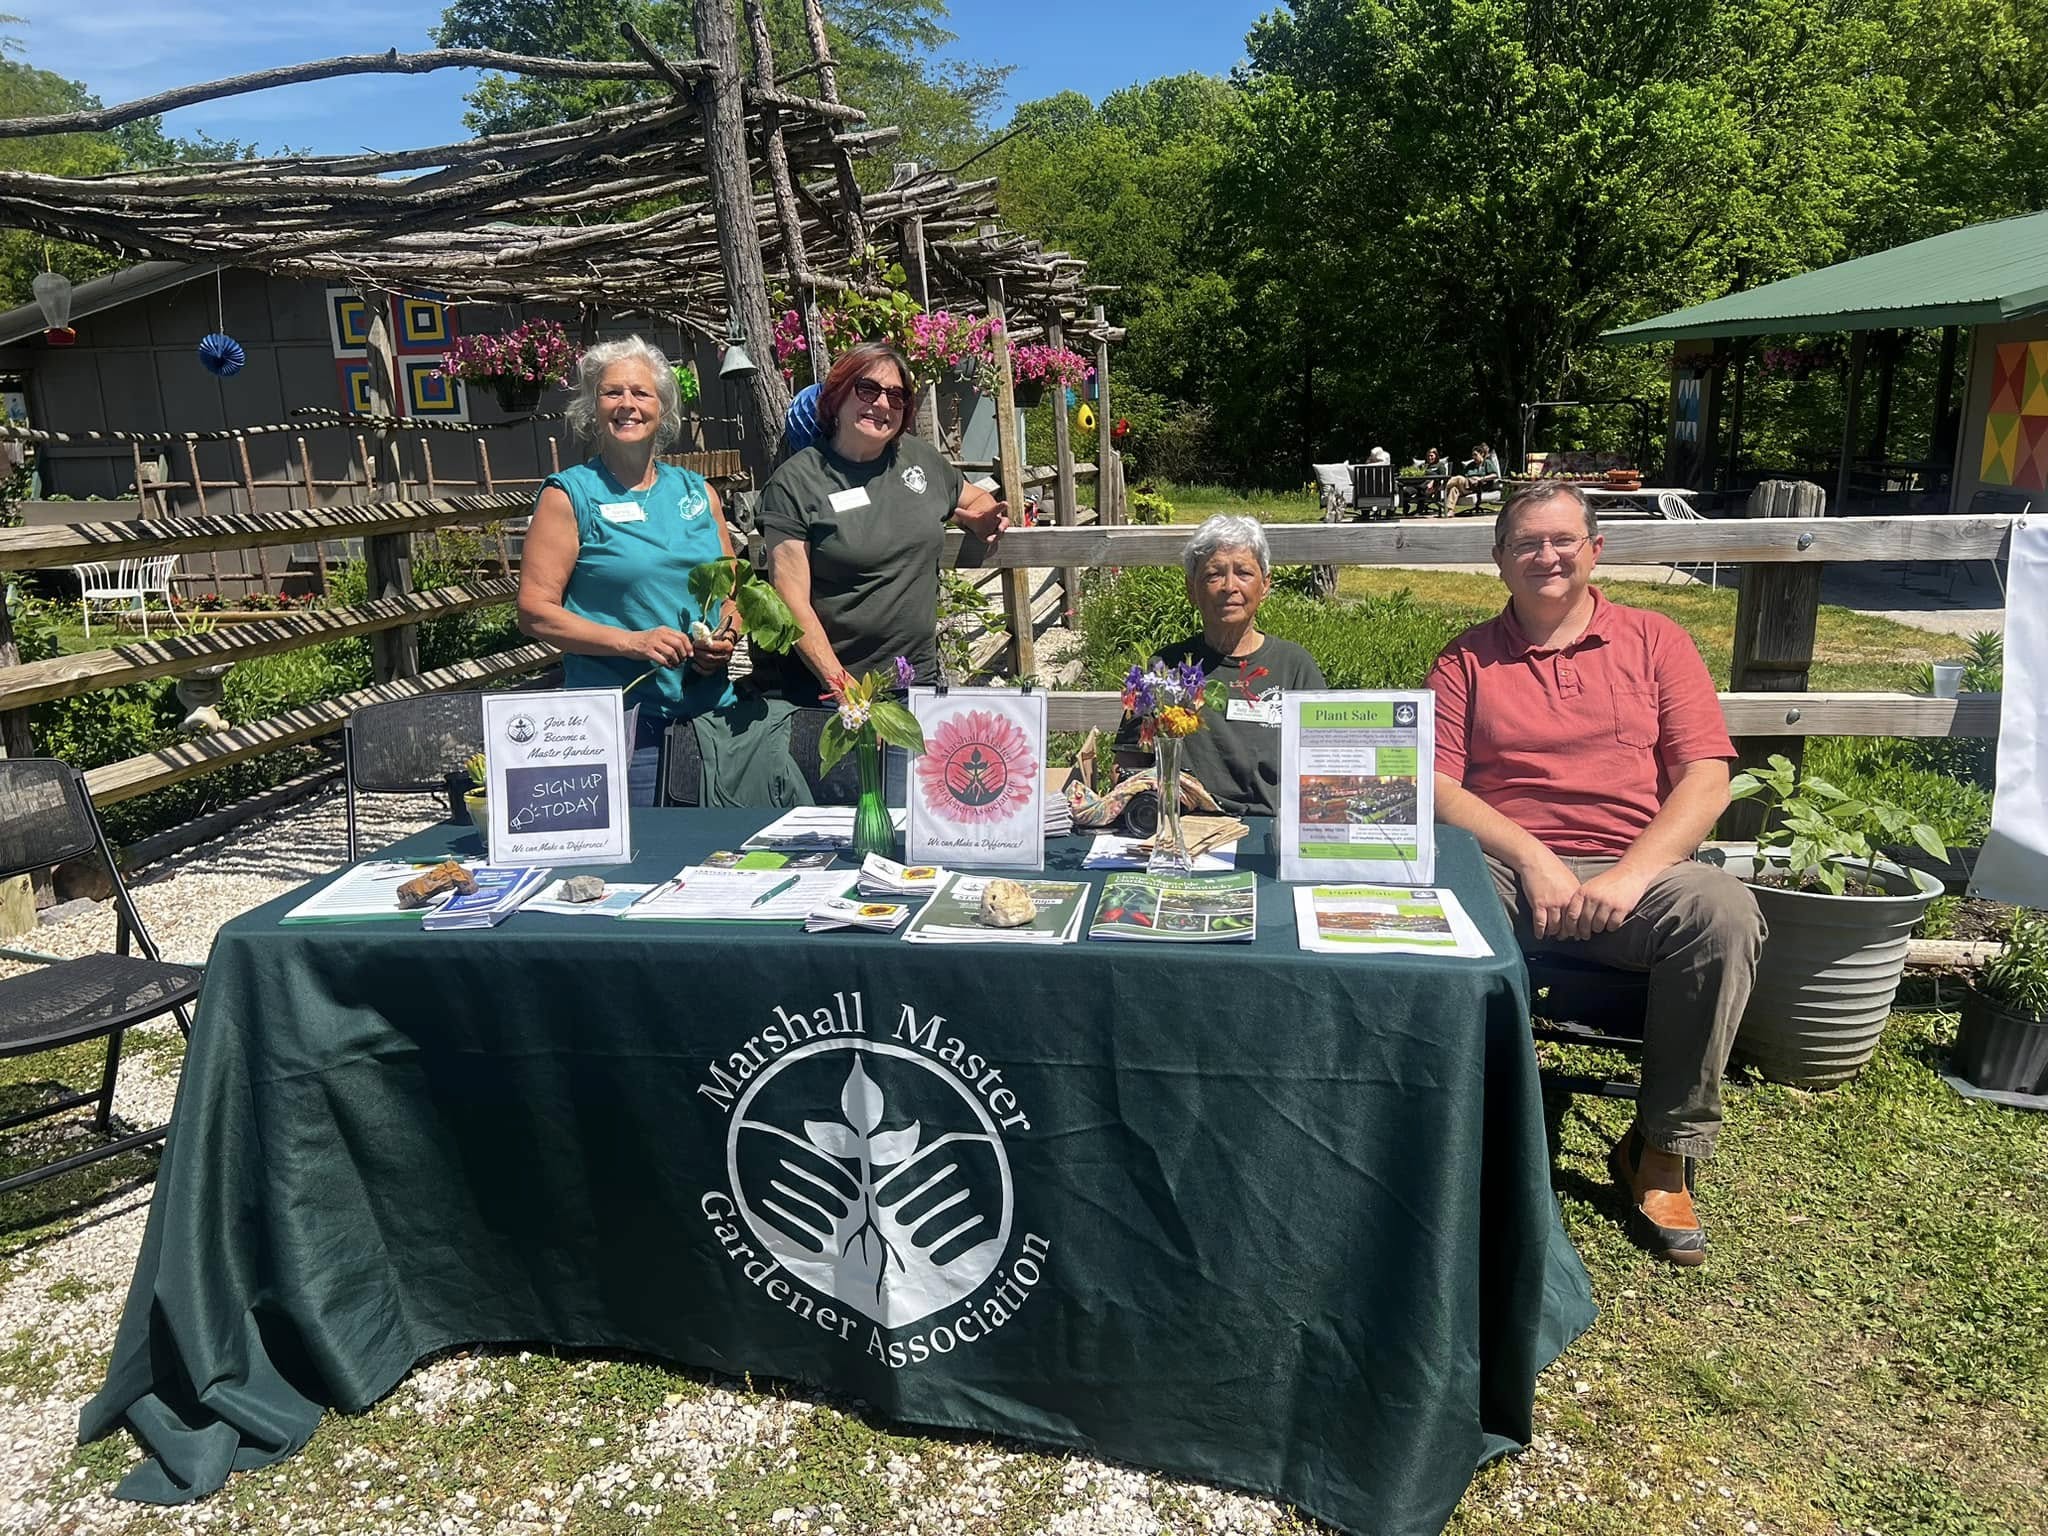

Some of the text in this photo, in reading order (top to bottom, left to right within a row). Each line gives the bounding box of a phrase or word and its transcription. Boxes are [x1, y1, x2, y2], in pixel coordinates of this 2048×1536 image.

[544, 715, 587, 730] Join Us!
[1315, 709, 1378, 721] Plant Sale
[544, 733, 578, 742] Become
[940, 732, 1013, 761] Marshall Master
[527, 746, 605, 760] Master Gardener
[532, 773, 602, 798] SIGN UP
[541, 795, 599, 818] TODAY
[937, 778, 1017, 816] Gardener Association
[512, 843, 523, 853] We
[539, 842, 557, 852] Make
[565, 839, 609, 852] Difference!
[927, 838, 939, 846] We
[951, 838, 972, 847] Make
[981, 838, 1024, 850] Difference!
[697, 991, 1031, 1133] Marshall Master
[701, 1190, 1051, 1368] Gardener Association
